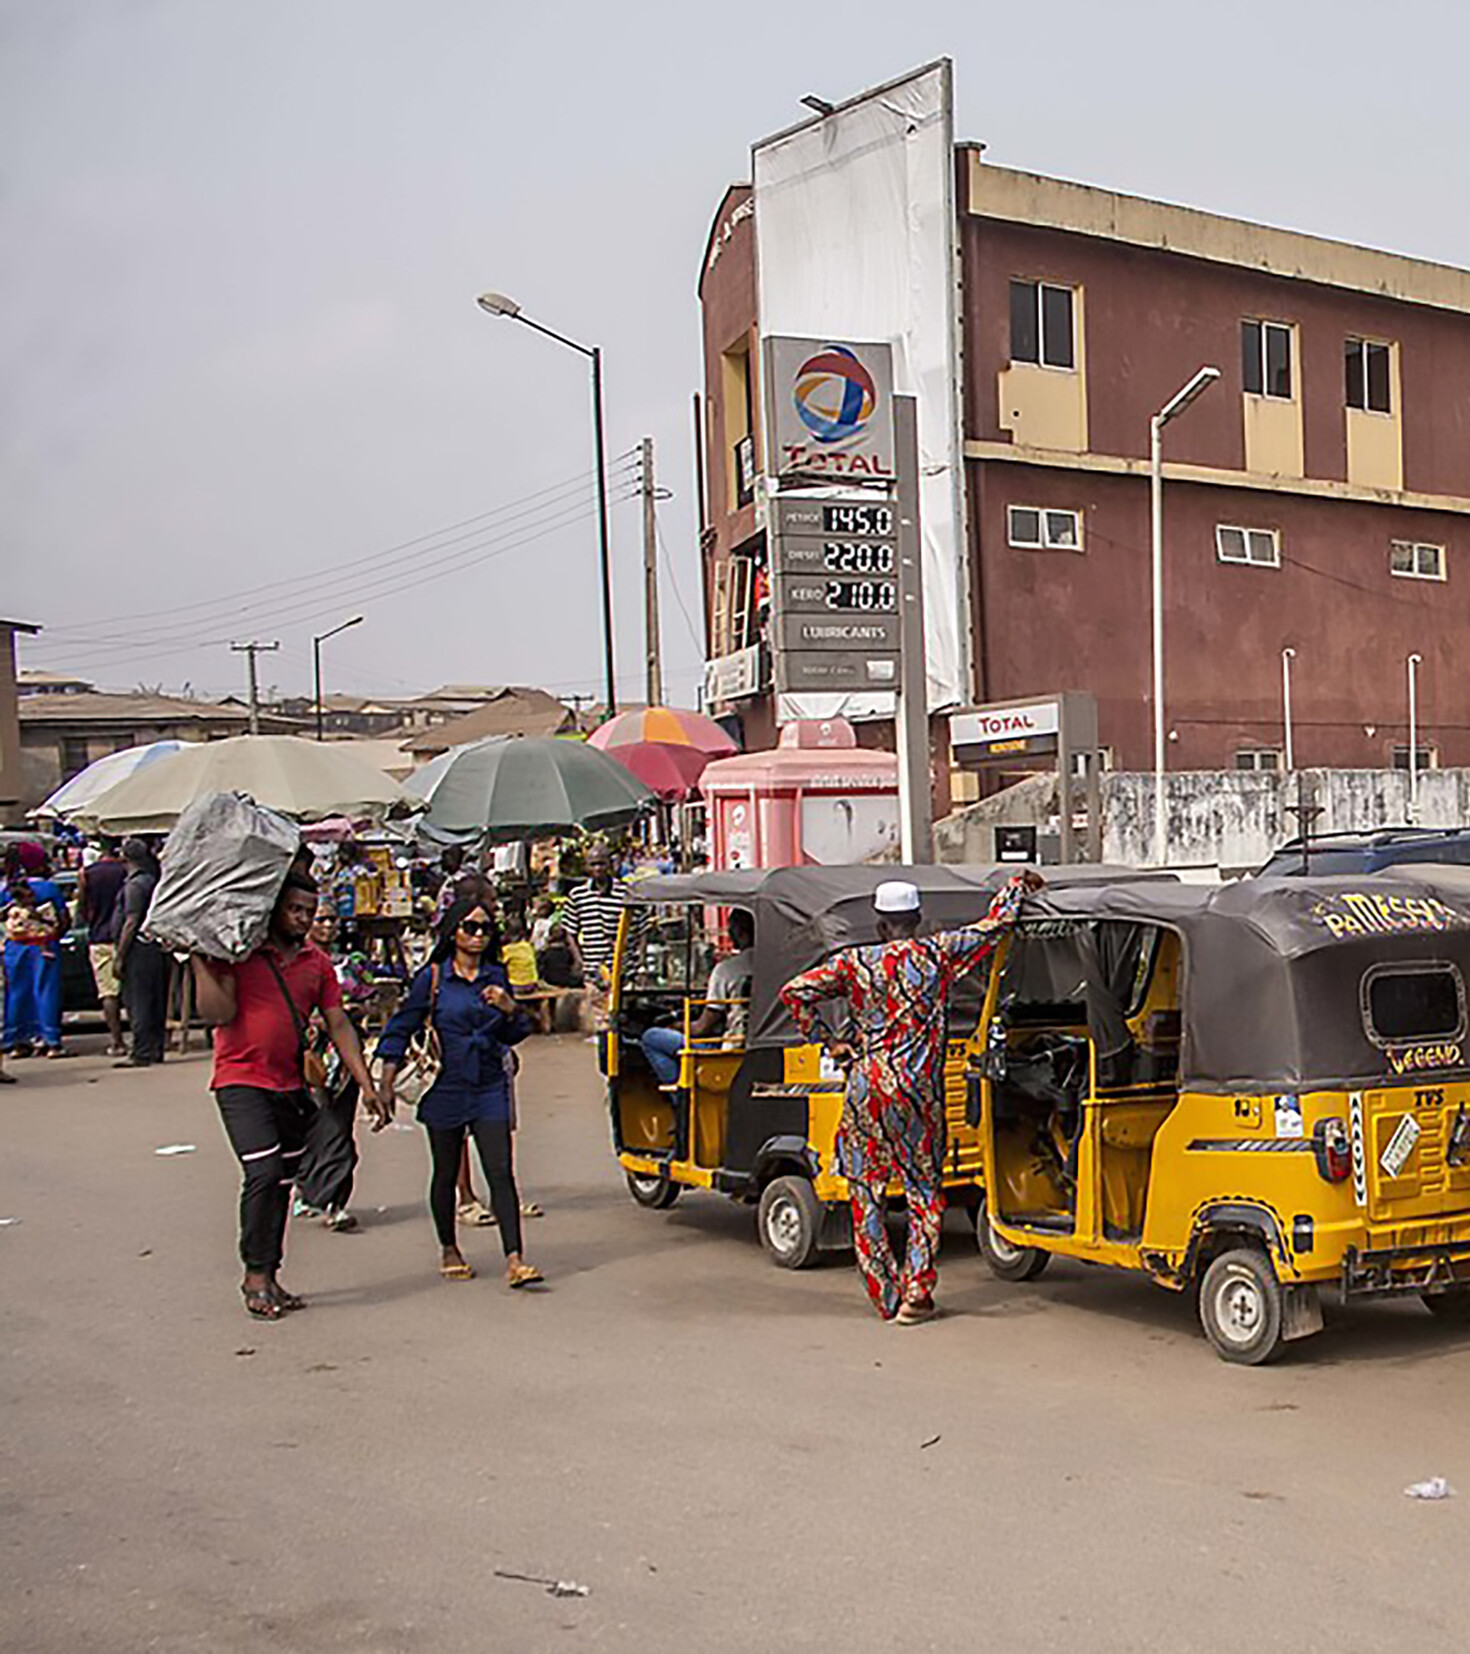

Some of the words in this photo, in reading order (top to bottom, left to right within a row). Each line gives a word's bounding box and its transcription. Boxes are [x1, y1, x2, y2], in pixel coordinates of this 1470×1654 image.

[782, 445, 892, 475] TOTAL
[831, 507, 893, 535] 145.0
[823, 543, 894, 572] 220.0
[790, 588, 824, 600] KERO
[824, 581, 895, 609] 210.0
[802, 626, 887, 639] LUBRICANTS
[978, 714, 1035, 734] TOTAL
[1415, 1088, 1445, 1107] TVS
